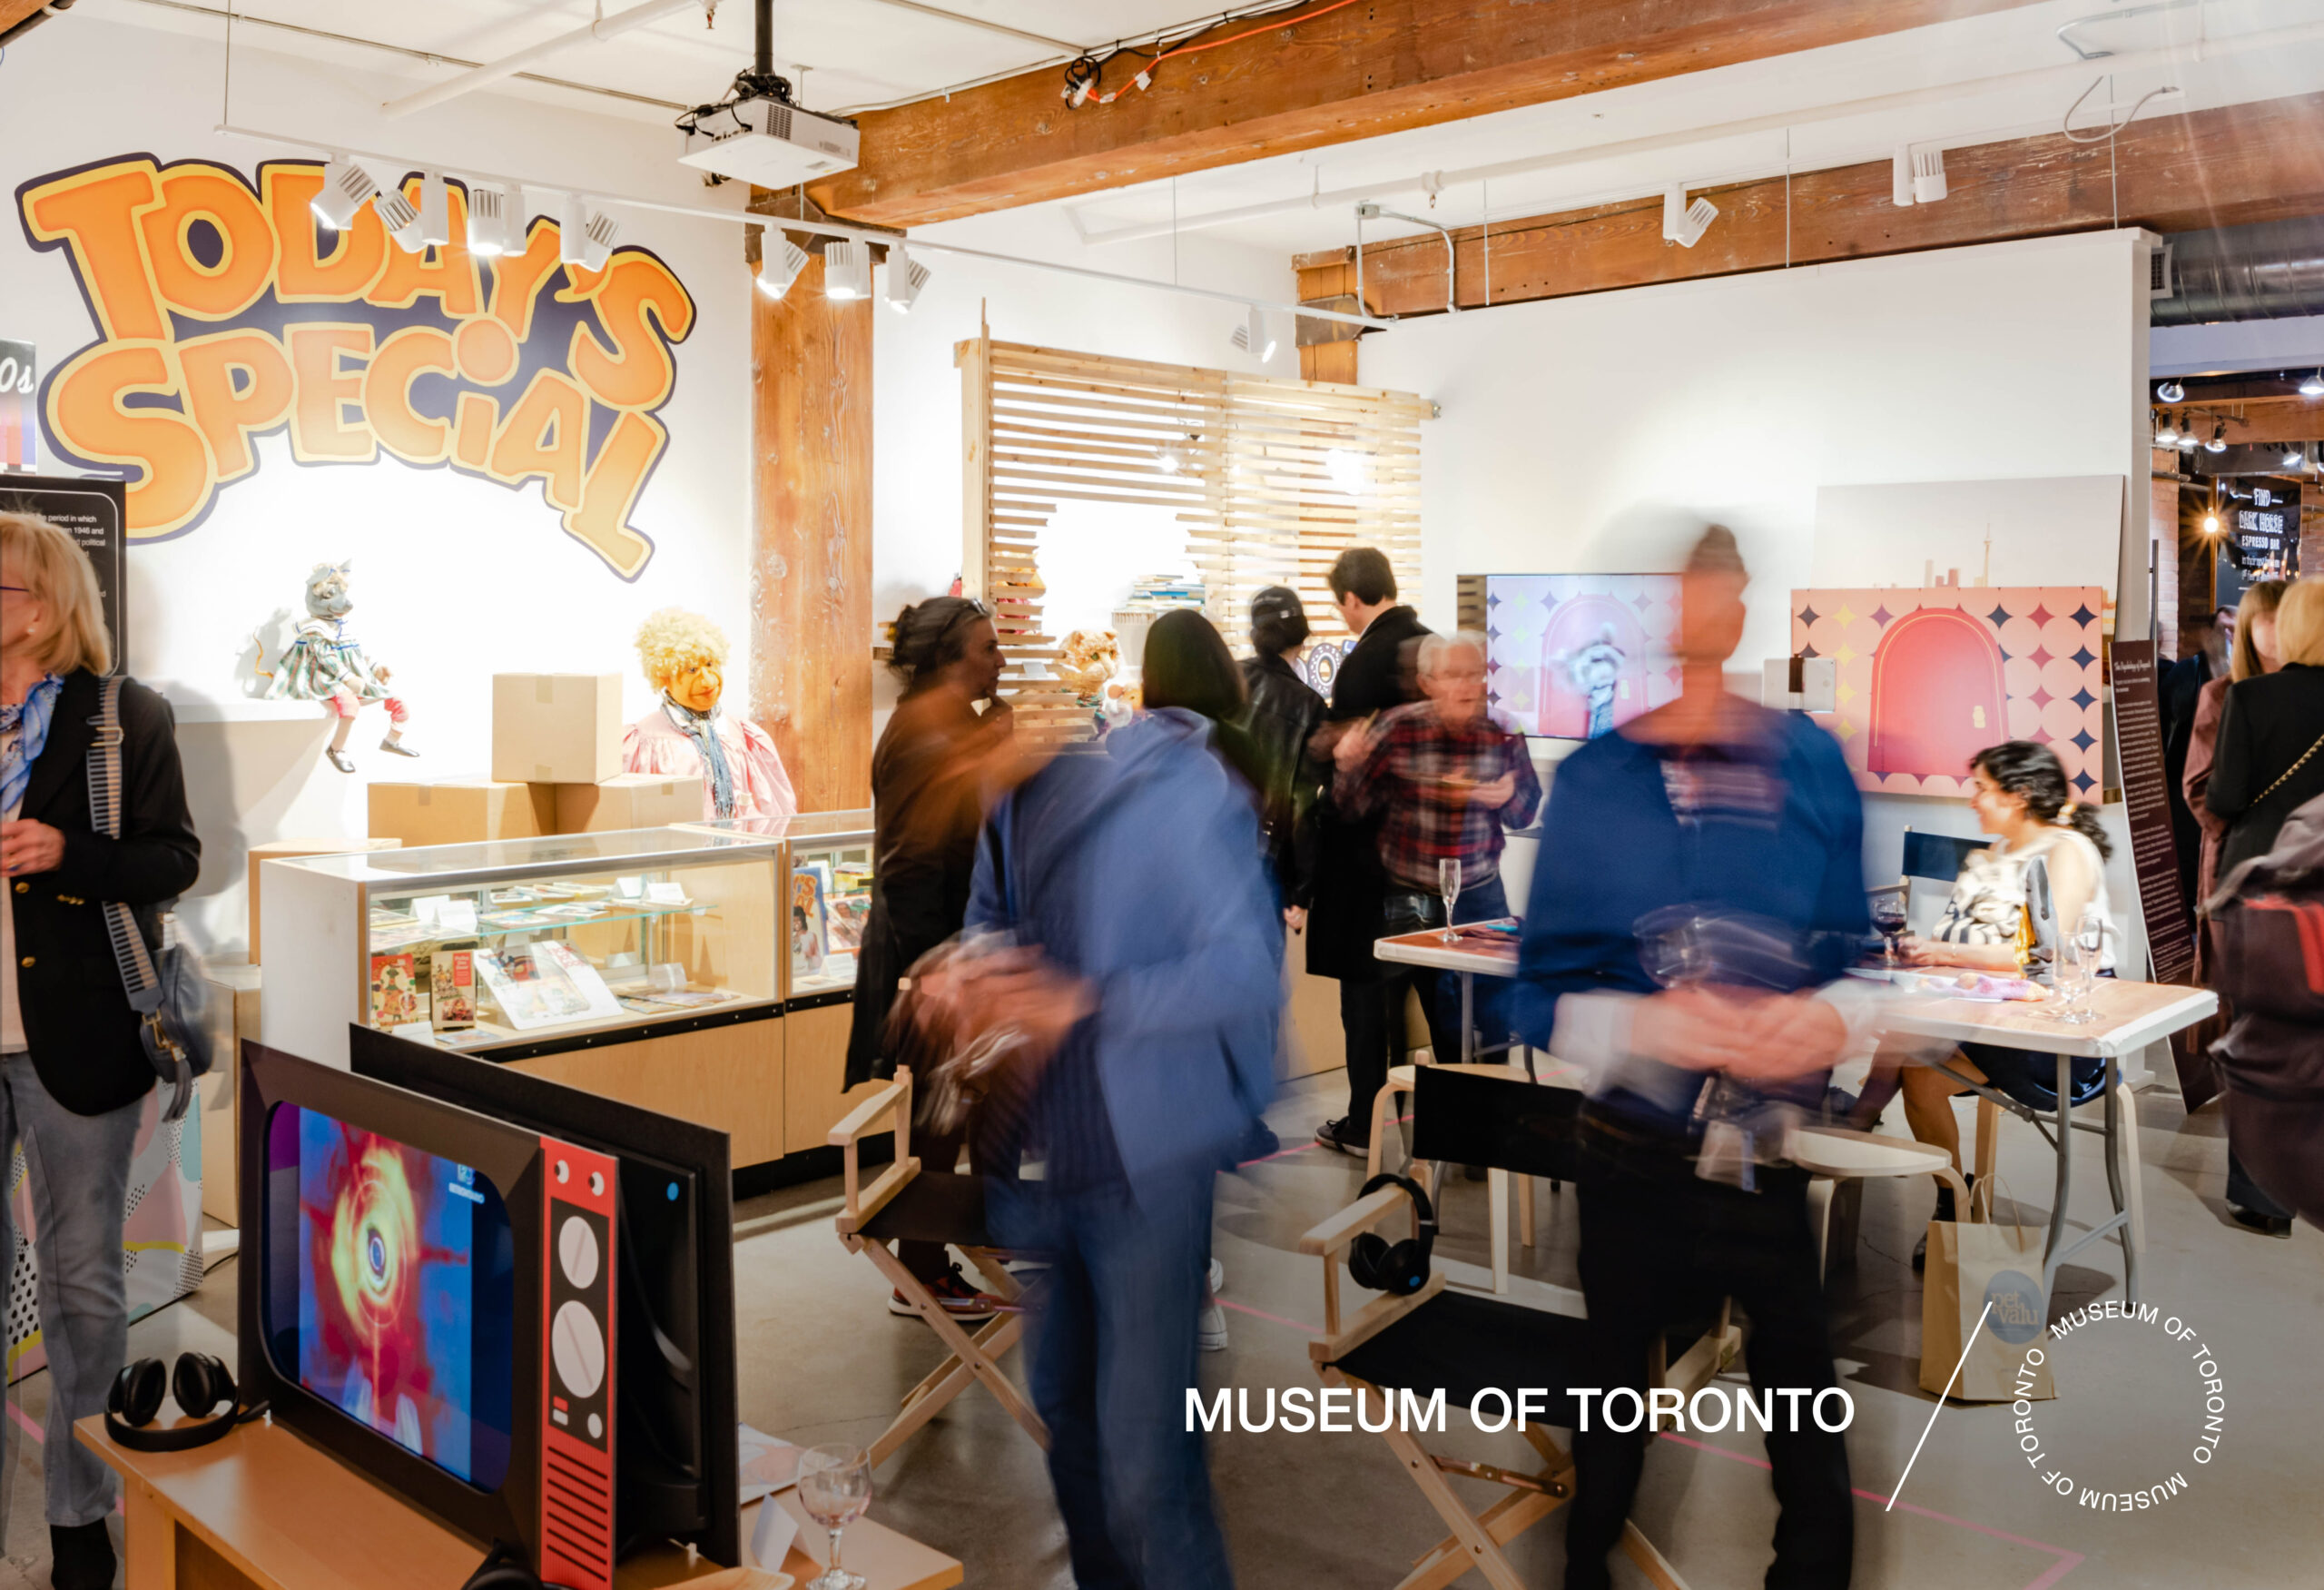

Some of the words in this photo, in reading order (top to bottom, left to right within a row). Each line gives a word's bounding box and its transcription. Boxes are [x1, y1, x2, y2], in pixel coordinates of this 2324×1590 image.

[2253, 488, 2271, 507] FIND
[47, 515, 69, 523] period
[77, 515, 97, 523] which
[2239, 510, 2259, 531] DARK
[2259, 512, 2284, 534] HORSE
[91, 527, 104, 535] and
[81, 538, 106, 547] political
[2241, 535, 2269, 549] ESPRESSO
[1990, 1289, 2020, 1315] pet
[1998, 1302, 2040, 1326] valu
